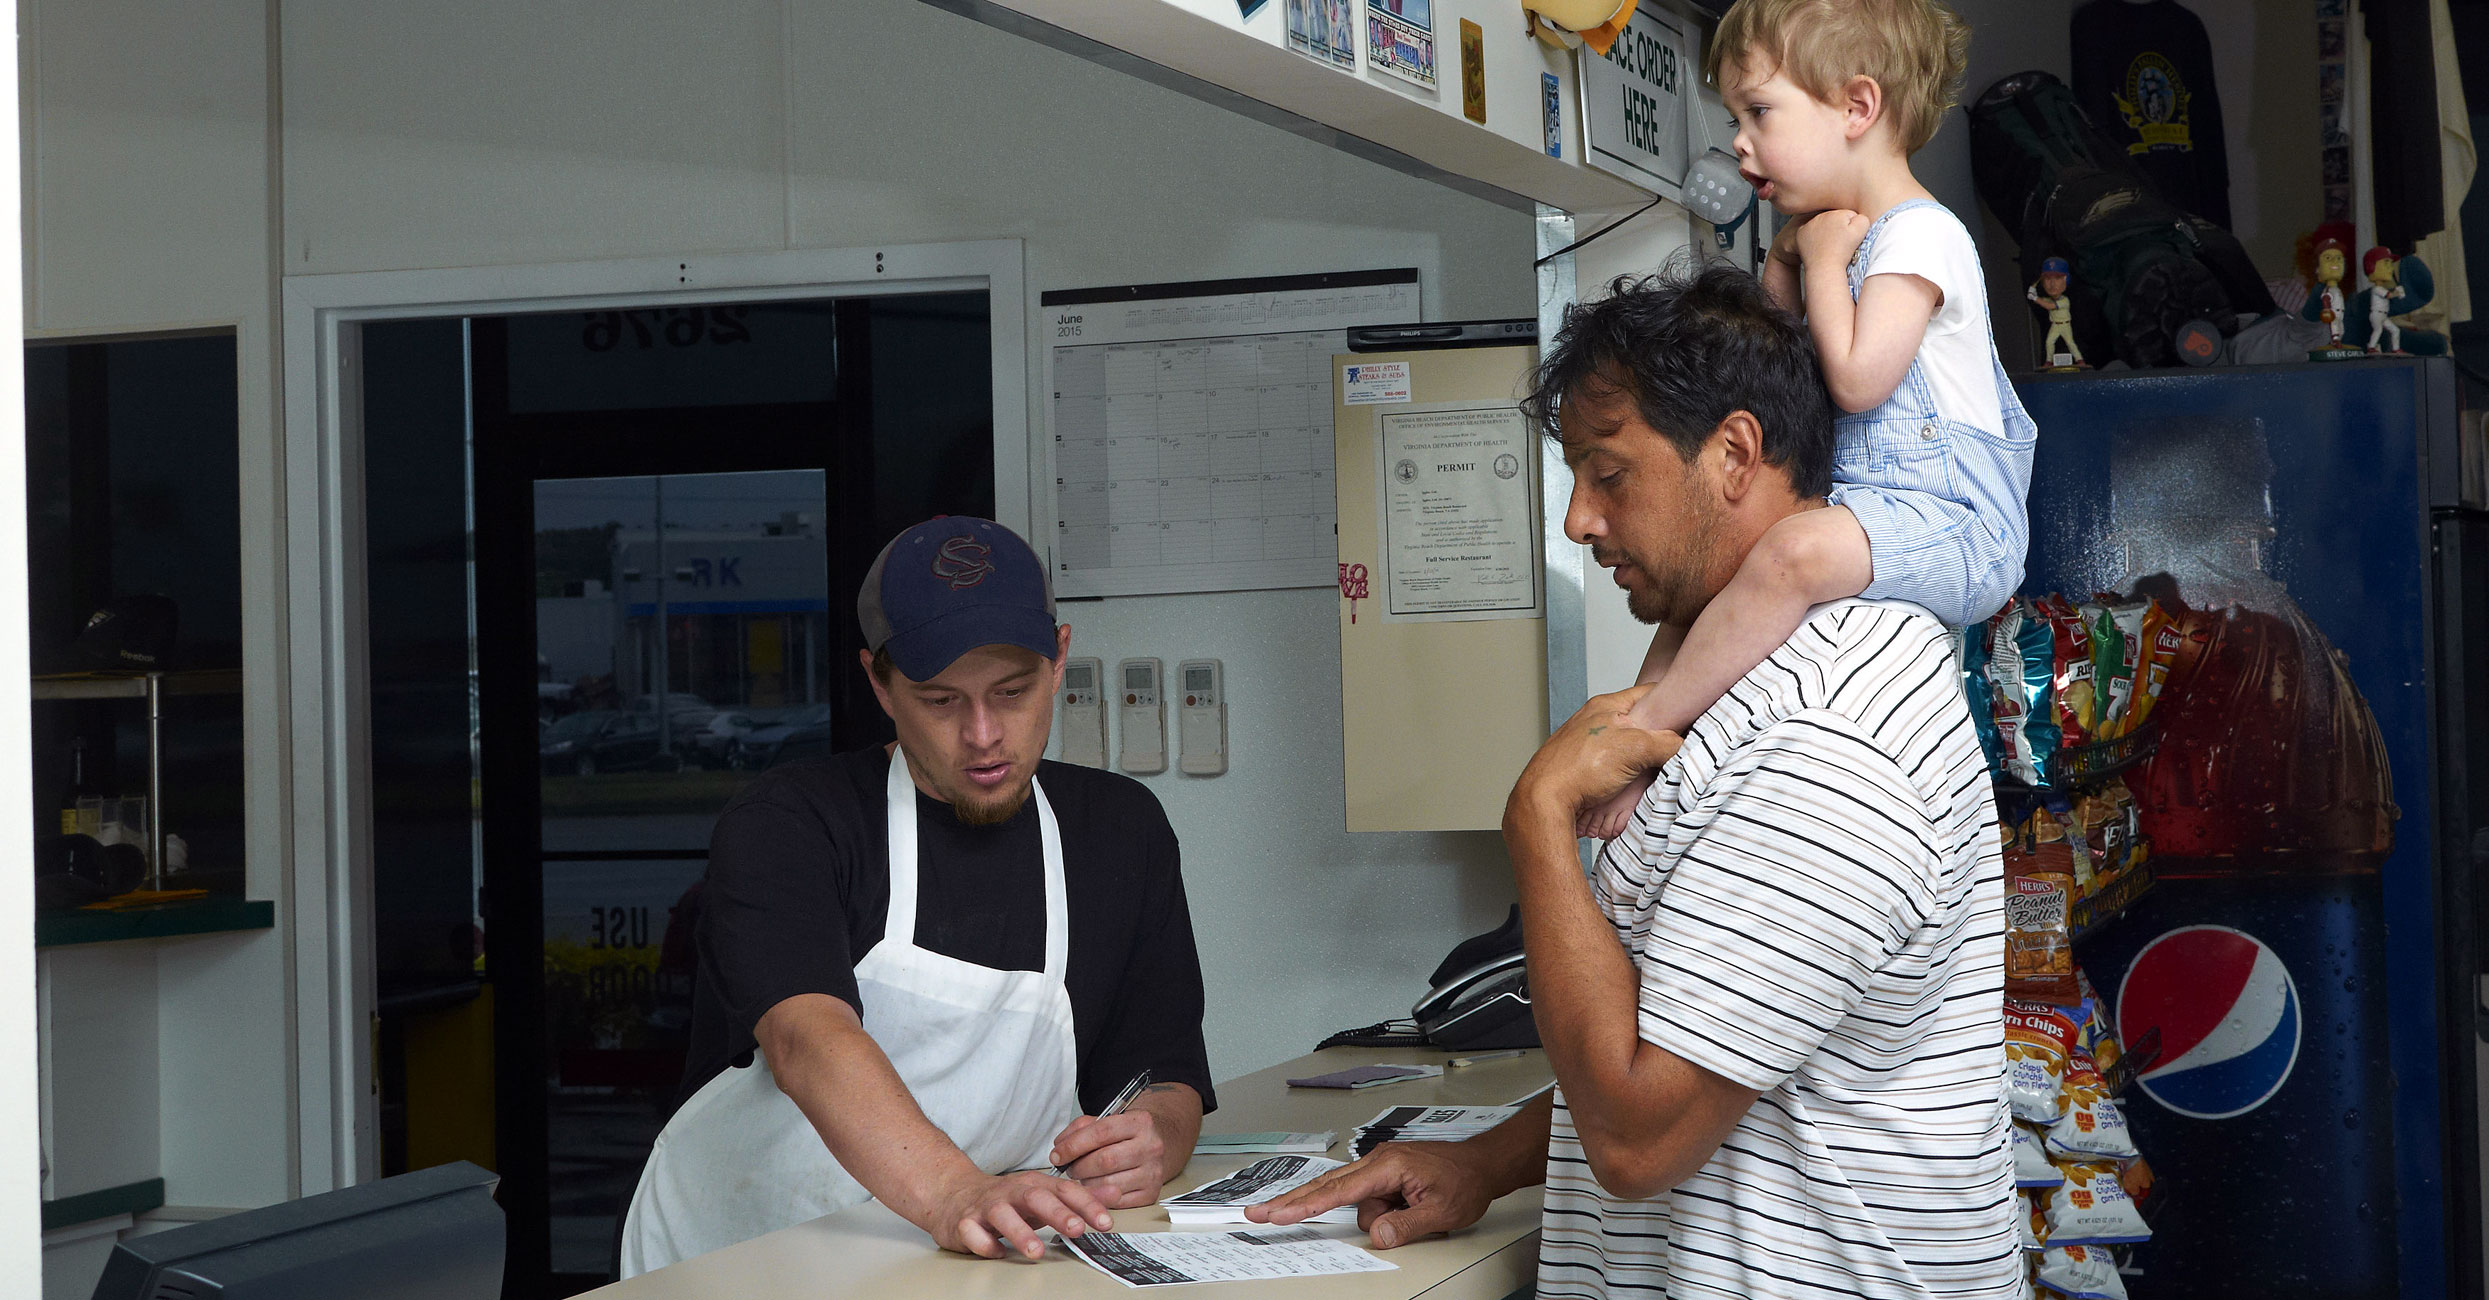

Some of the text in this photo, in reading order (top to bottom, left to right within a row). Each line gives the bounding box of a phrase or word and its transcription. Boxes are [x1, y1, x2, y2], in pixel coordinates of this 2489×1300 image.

[1637, 31, 1677, 96] ORDER
[1622, 83, 1660, 157] HERE
[1057, 314, 1083, 325] June
[1057, 326, 1082, 337] 2015
[2326, 350, 2347, 358] STEVE
[1432, 442, 1472, 450] DEPARTMENT
[1436, 462, 1476, 472] PERMIT
[2005, 892, 2065, 913] Peanut
[2014, 908, 2062, 926] Butter
[2025, 1017, 2064, 1038] Chips
[2006, 1030, 2028, 1039] lassic
[2013, 1070, 2044, 1081] Crunchy
